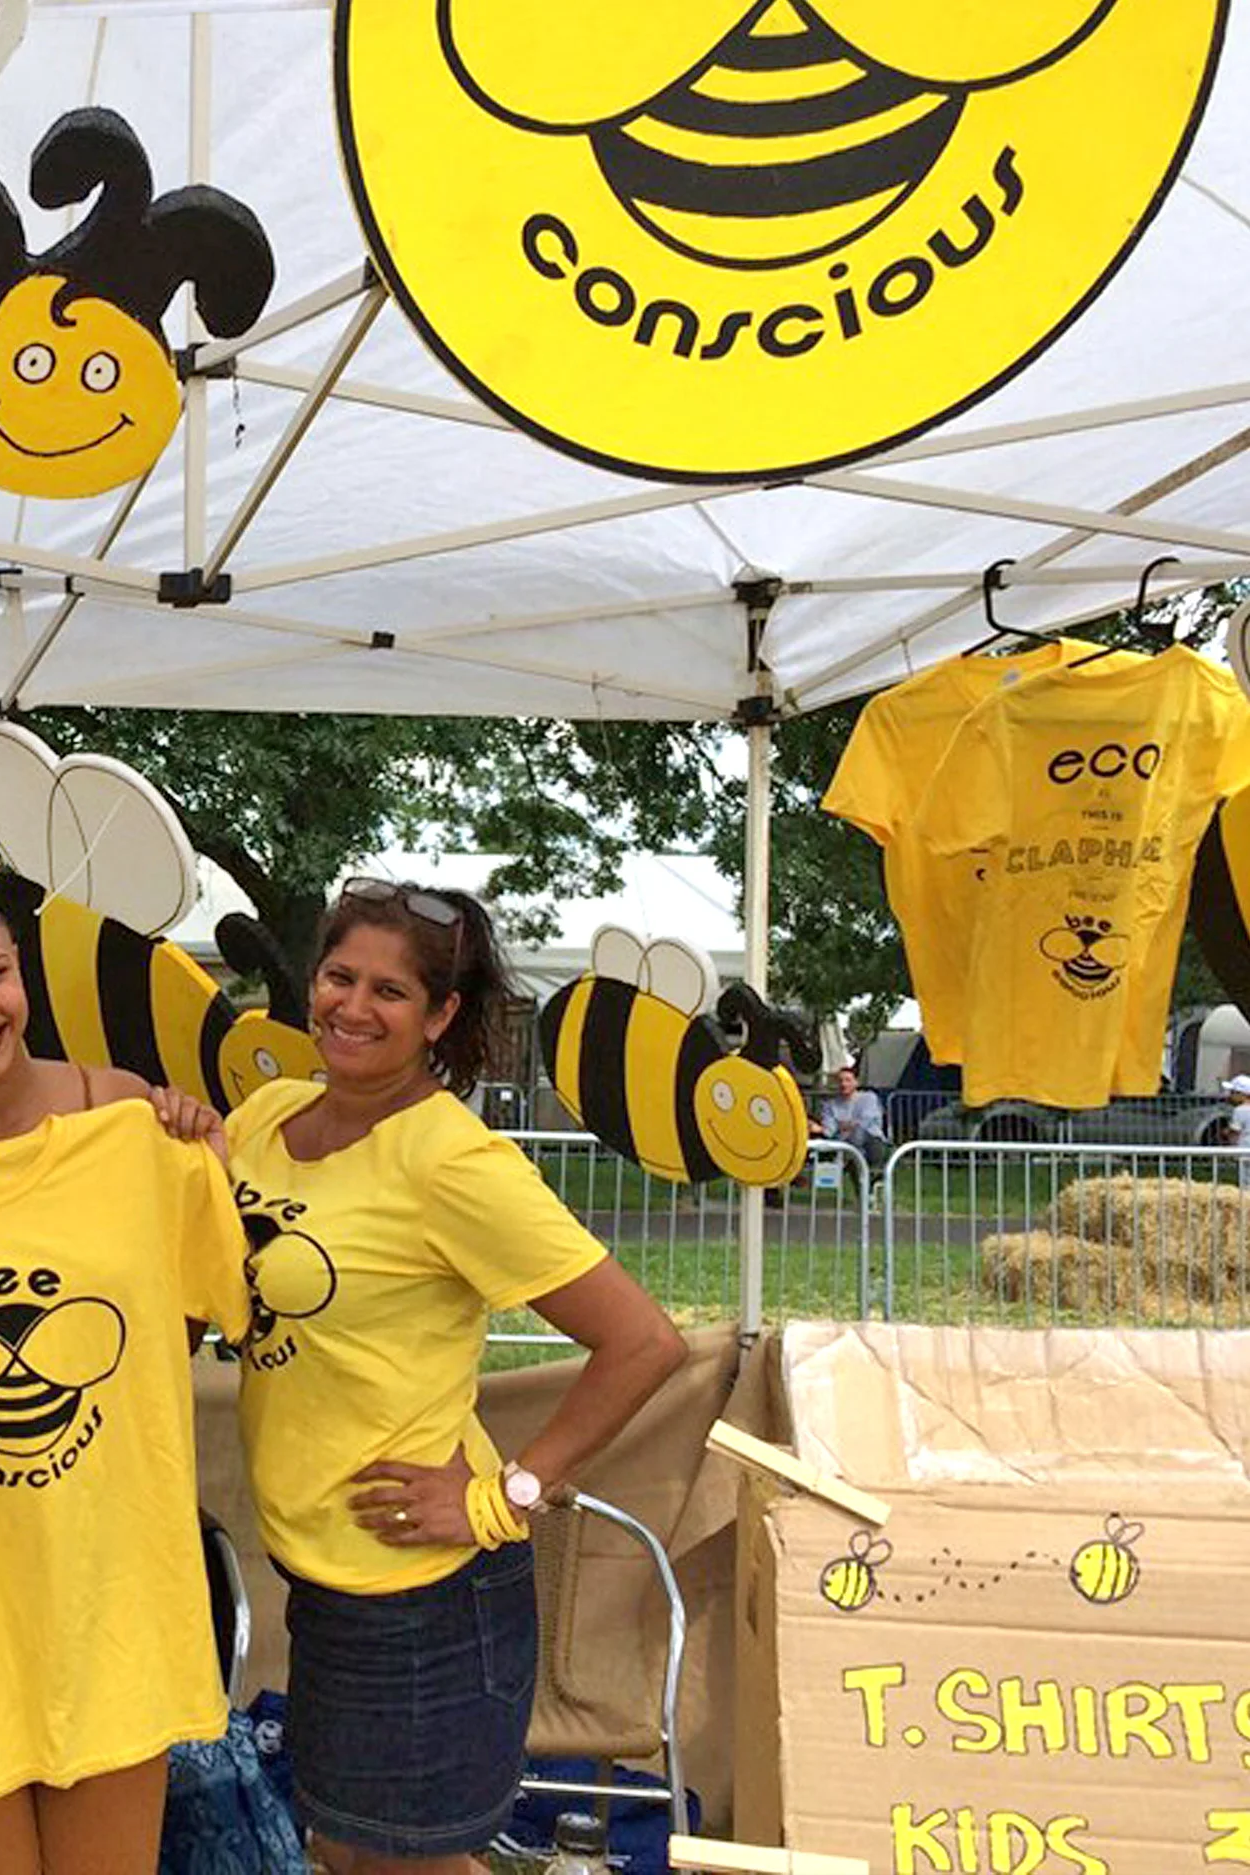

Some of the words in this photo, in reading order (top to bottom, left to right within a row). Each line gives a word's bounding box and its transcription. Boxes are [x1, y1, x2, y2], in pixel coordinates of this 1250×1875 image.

[521, 145, 1025, 362] conscious
[1048, 742, 1161, 785] eco
[1005, 835, 1163, 874] CLAPH
[842, 1662, 1250, 1770] T.SHIRT
[891, 1803, 1111, 1875] KIDS
